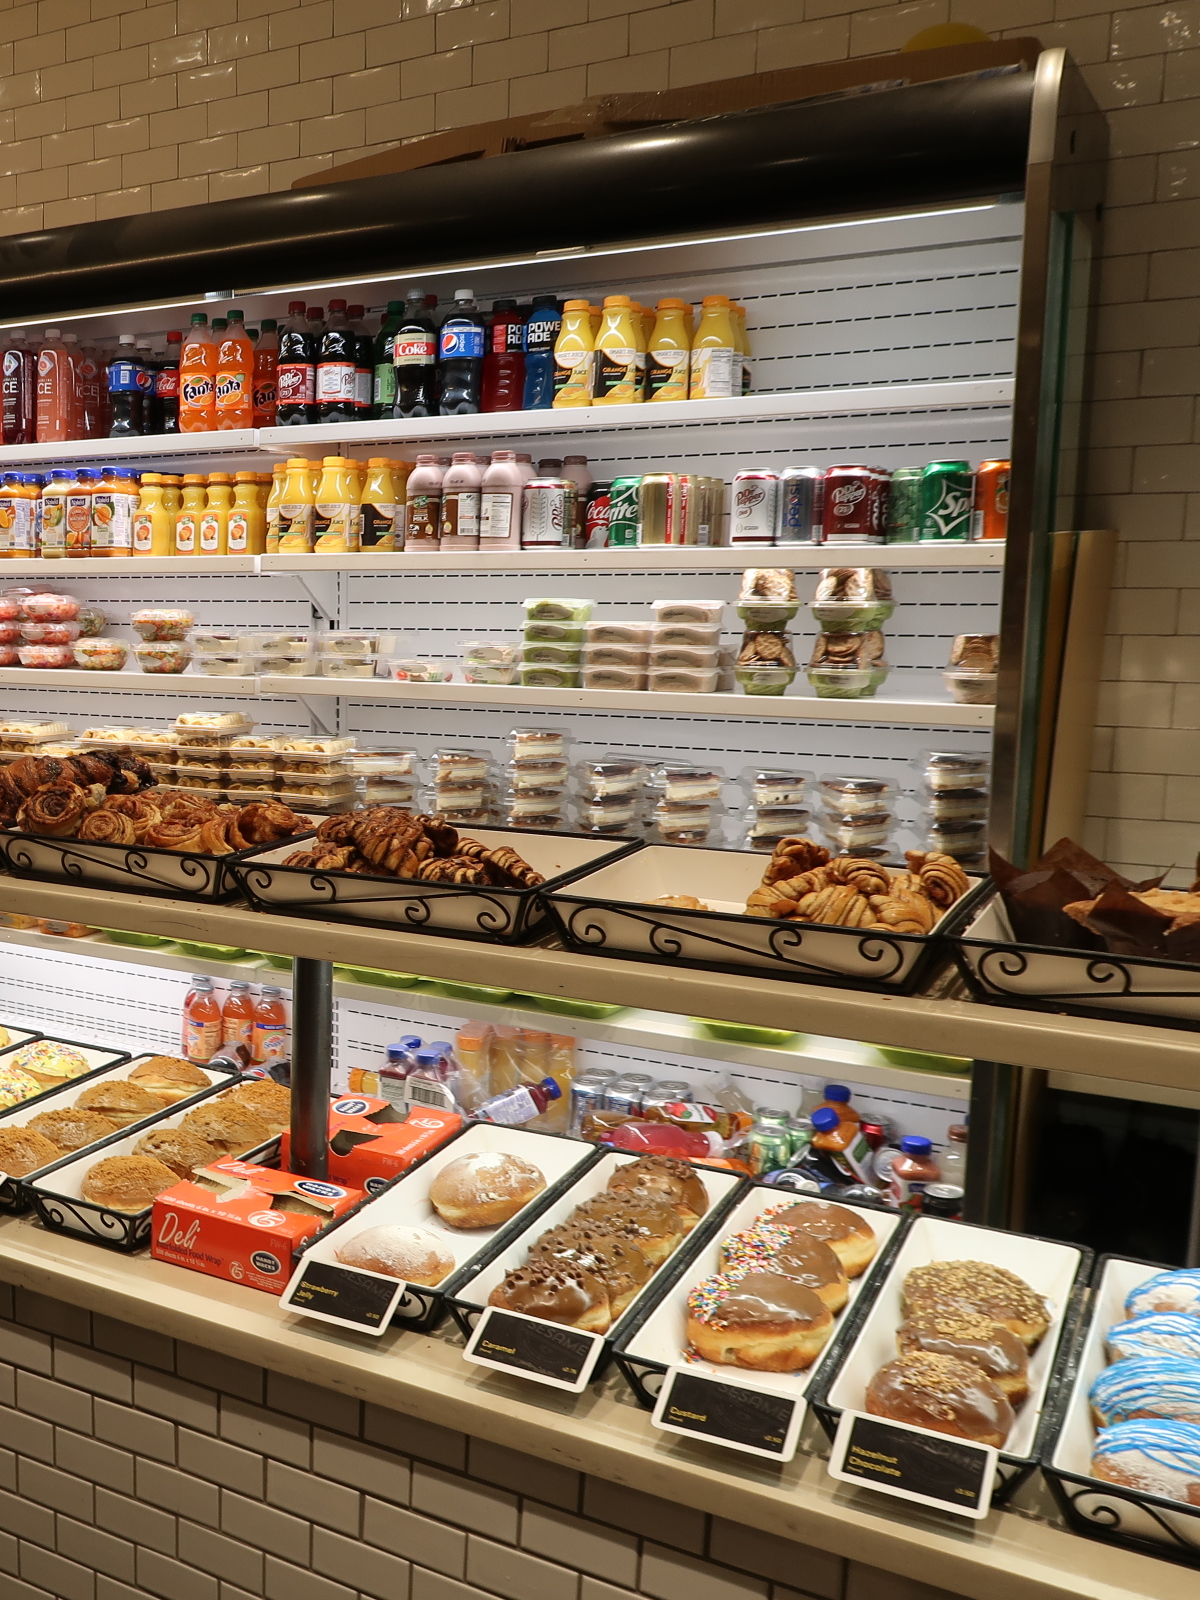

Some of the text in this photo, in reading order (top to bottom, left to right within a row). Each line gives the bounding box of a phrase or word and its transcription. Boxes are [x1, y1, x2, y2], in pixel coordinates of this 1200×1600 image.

[528, 321, 560, 333] POWE
[507, 334, 522, 344] AD
[527, 332, 551, 343] ADE
[399, 343, 427, 355] Coke
[3, 382, 18, 393] CE
[37, 383, 52, 394] CE
[216, 380, 241, 398] anta
[586, 501, 610, 519] Coca
[610, 501, 637, 520] rite
[158, 1212, 201, 1250] Deli
[188, 1248, 205, 1260] Food
[301, 1281, 339, 1297] Strawberry
[340, 1270, 393, 1301] SESAME
[526, 1321, 589, 1356] SESAME
[481, 1339, 516, 1355] Caramel
